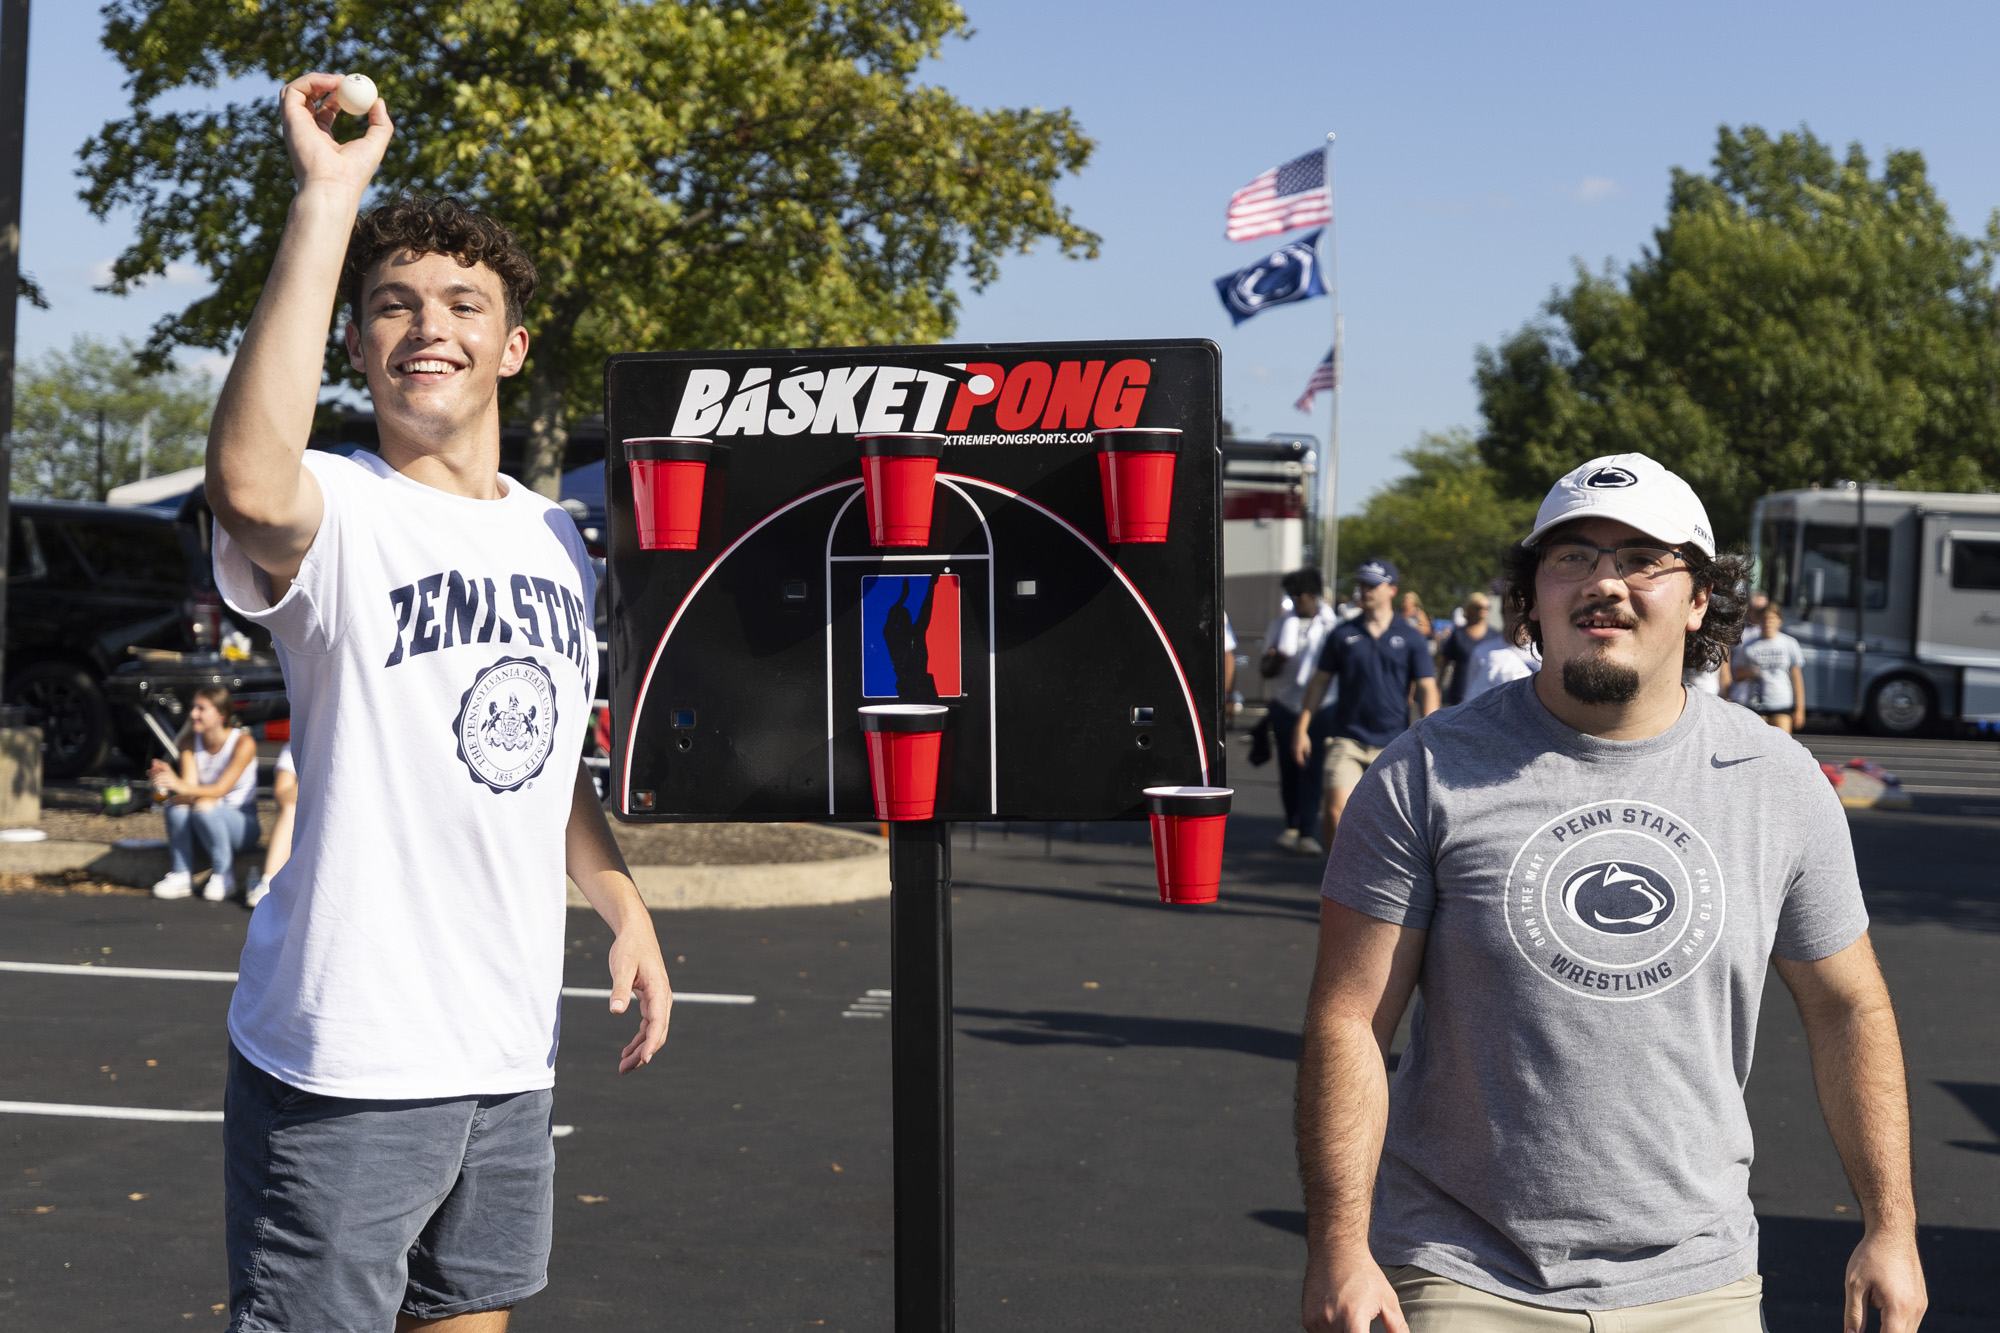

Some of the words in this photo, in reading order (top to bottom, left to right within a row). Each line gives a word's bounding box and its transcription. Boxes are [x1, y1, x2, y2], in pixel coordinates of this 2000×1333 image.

[523, 669, 545, 696] STATE
[467, 668, 520, 738] PENNSYLVANIA
[525, 697, 550, 773] UNIVERSITY
[468, 743, 486, 768] THE
[494, 771, 513, 782] 1855
[1551, 808, 1613, 842] PENN
[1622, 808, 1691, 848] STATE
[1525, 853, 1546, 883] MAT
[1695, 868, 1712, 894] PIN
[1521, 887, 1534, 912] THE
[1700, 902, 1713, 921] TO
[1524, 918, 1547, 947] OWN
[1682, 928, 1706, 956] WIN
[1550, 953, 1673, 991] WRESTLING
